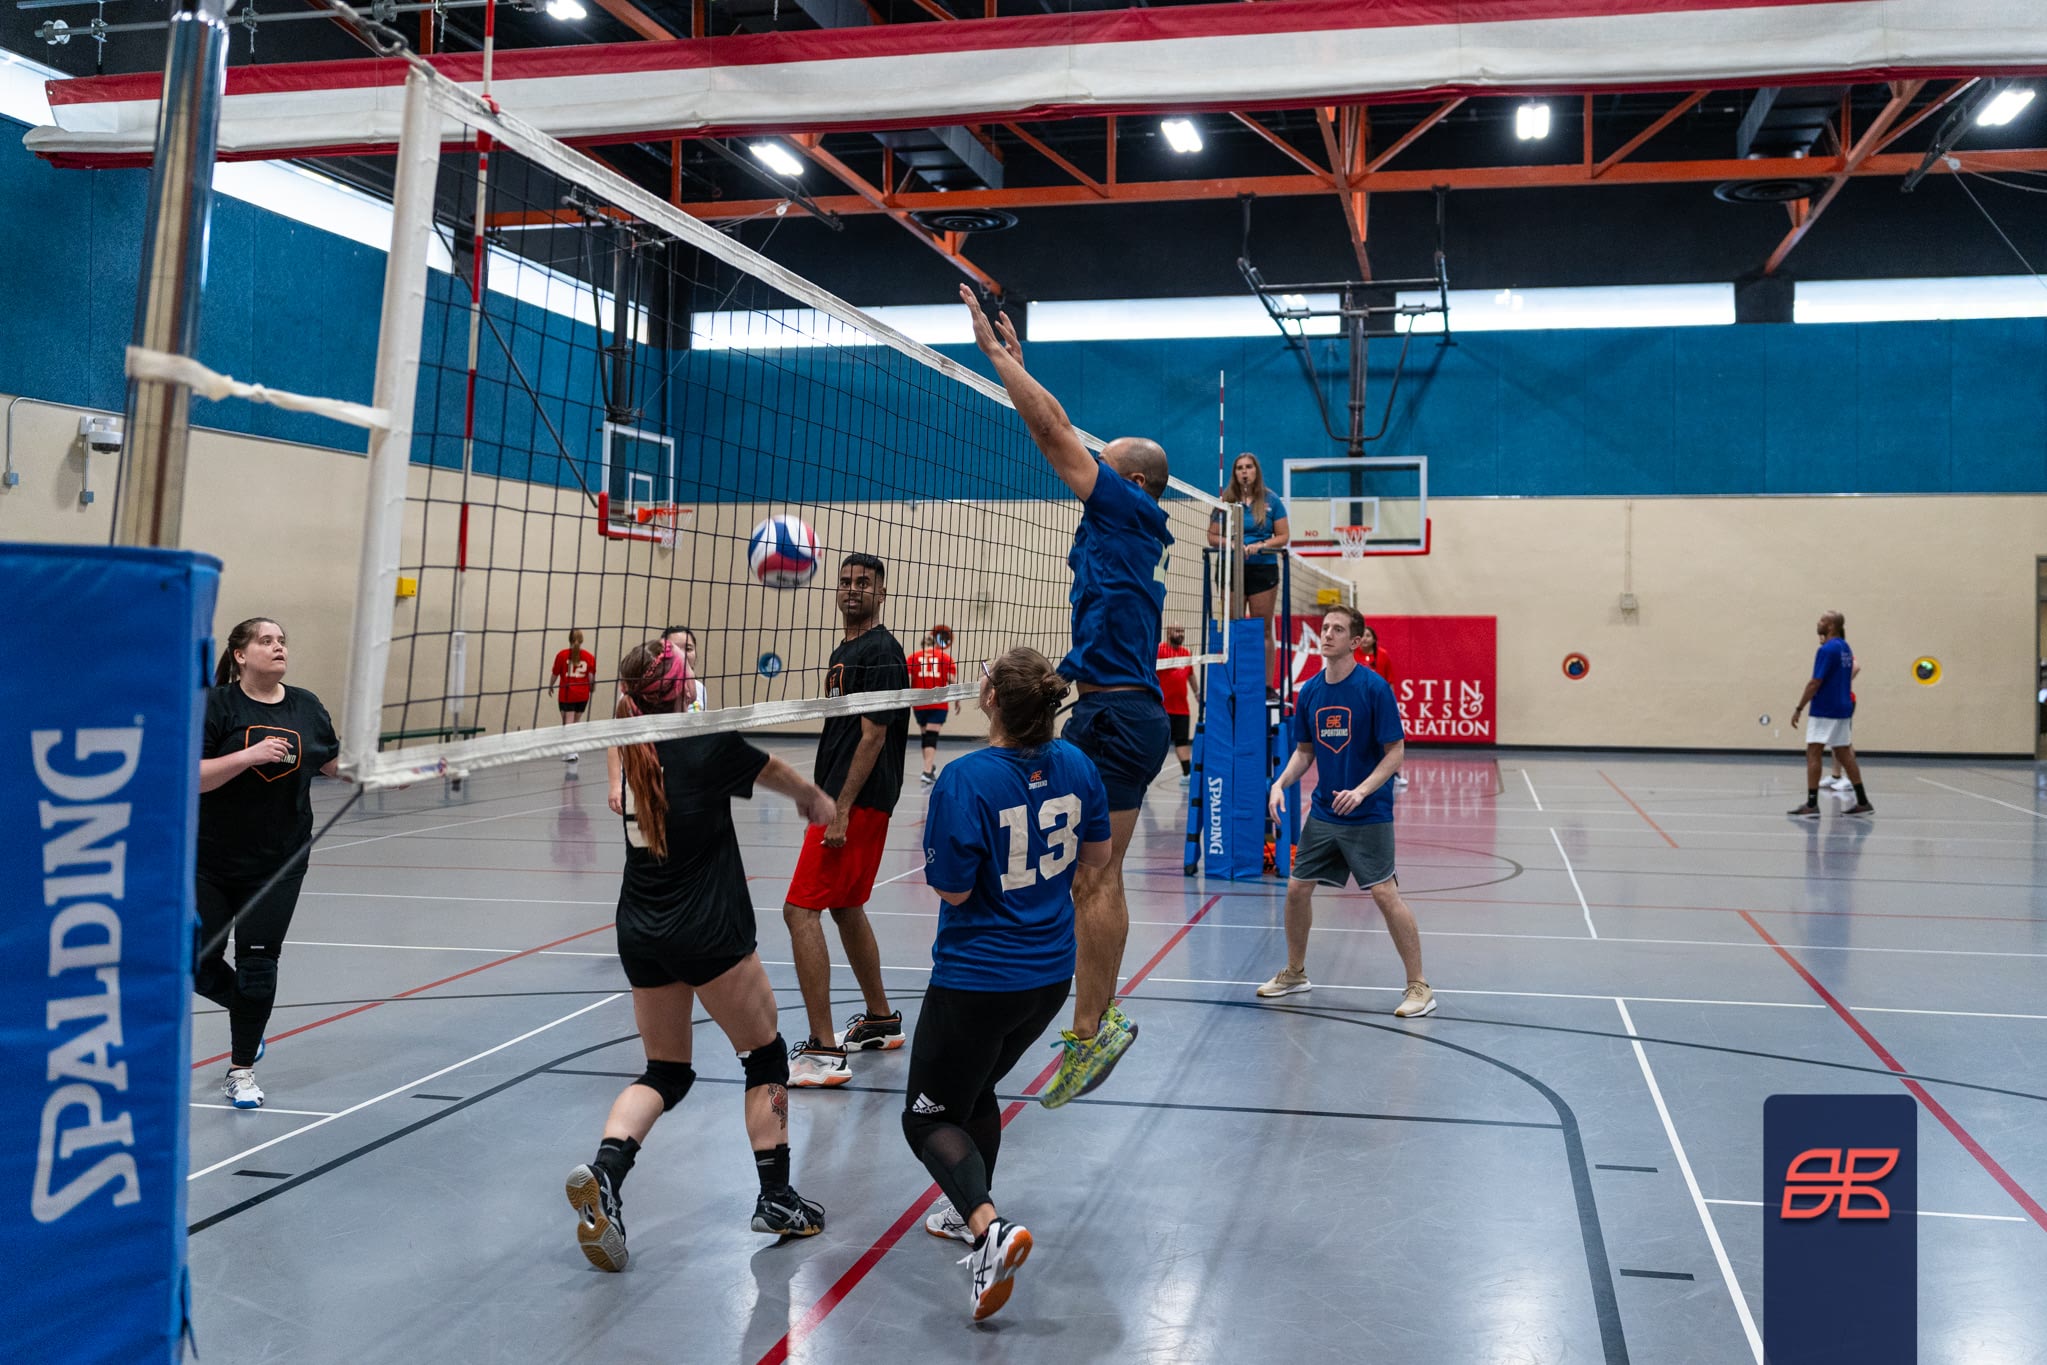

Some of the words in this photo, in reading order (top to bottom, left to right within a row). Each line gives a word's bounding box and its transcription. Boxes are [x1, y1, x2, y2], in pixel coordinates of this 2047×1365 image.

[566, 659, 588, 678] 12
[918, 656, 941, 678] 11
[1400, 679, 1481, 702] STIN
[1397, 702, 1452, 719] RKS
[1401, 718, 1490, 736] REATION
[1207, 776, 1224, 855] SPALDING
[998, 793, 1082, 893] 13
[31, 727, 145, 1223] SPALDING
